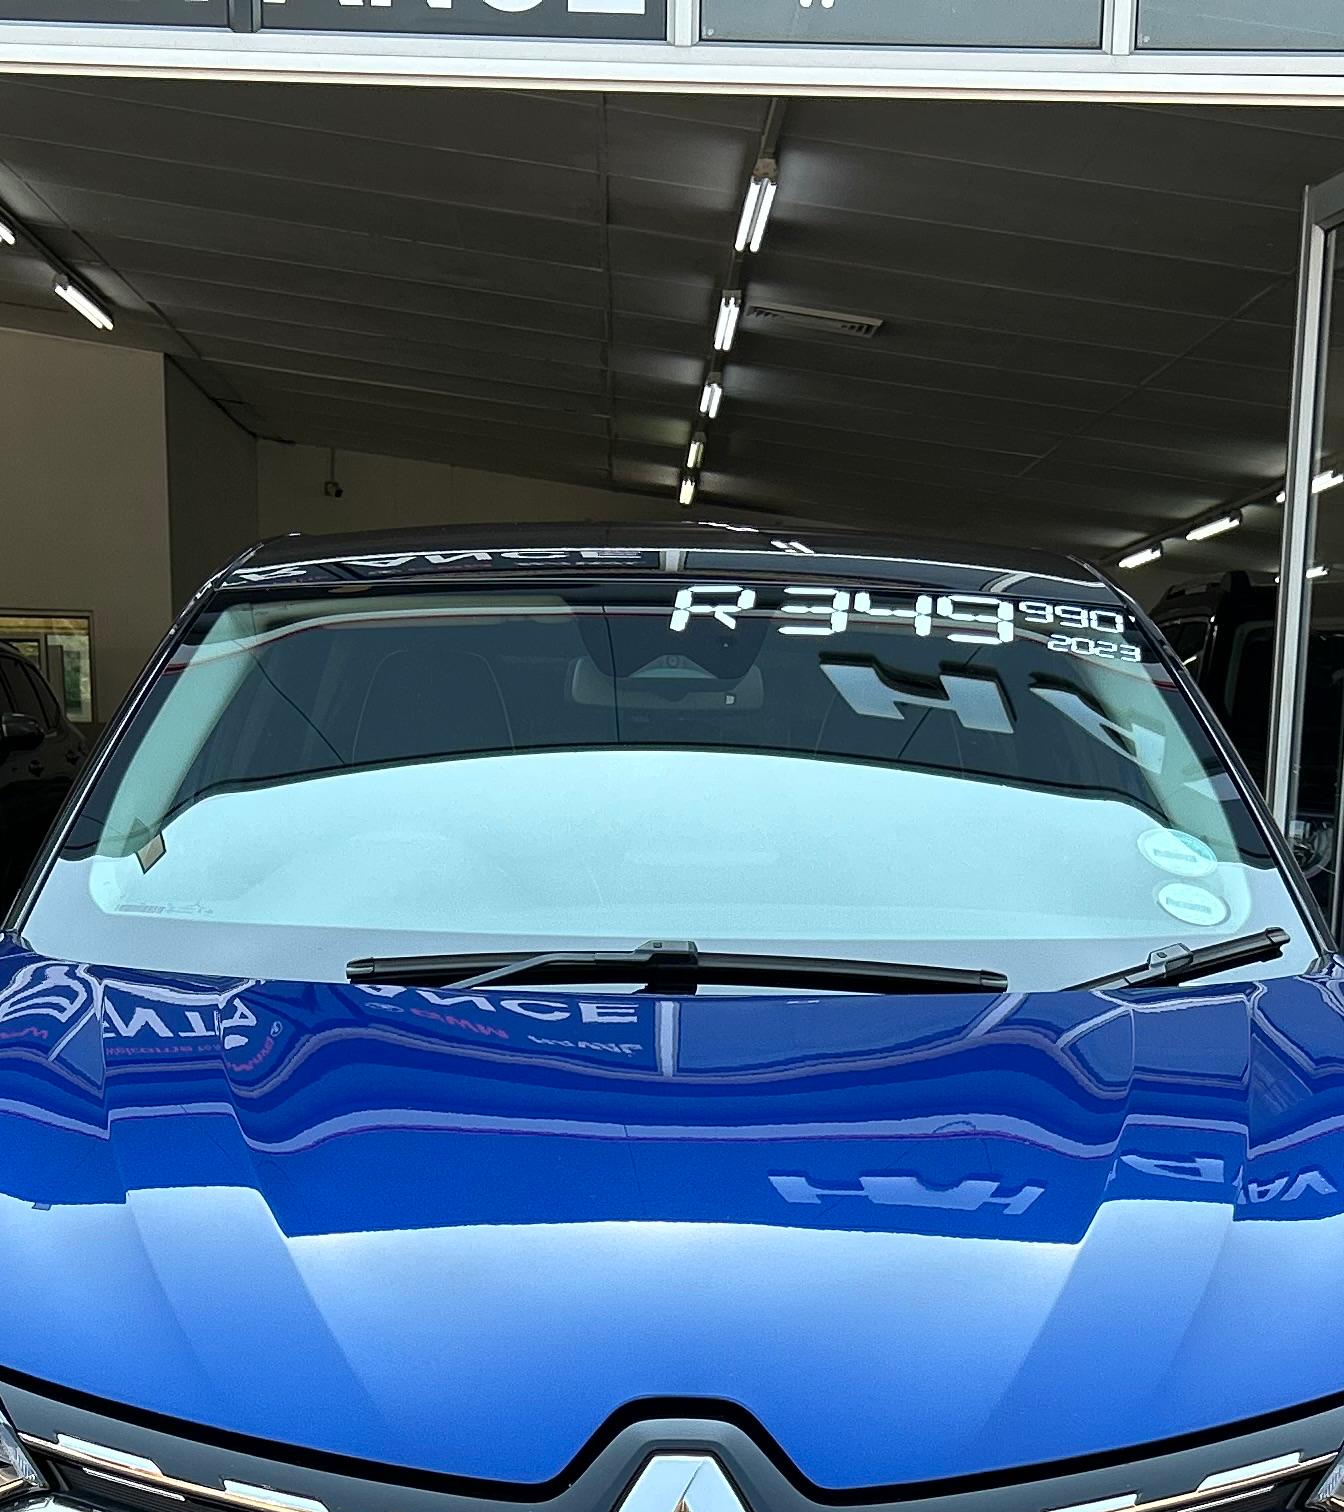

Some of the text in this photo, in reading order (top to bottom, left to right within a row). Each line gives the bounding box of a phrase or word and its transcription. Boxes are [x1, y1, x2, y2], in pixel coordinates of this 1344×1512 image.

[669, 585, 1124, 645] R 349 990
[1047, 634, 1142, 663] 2023
